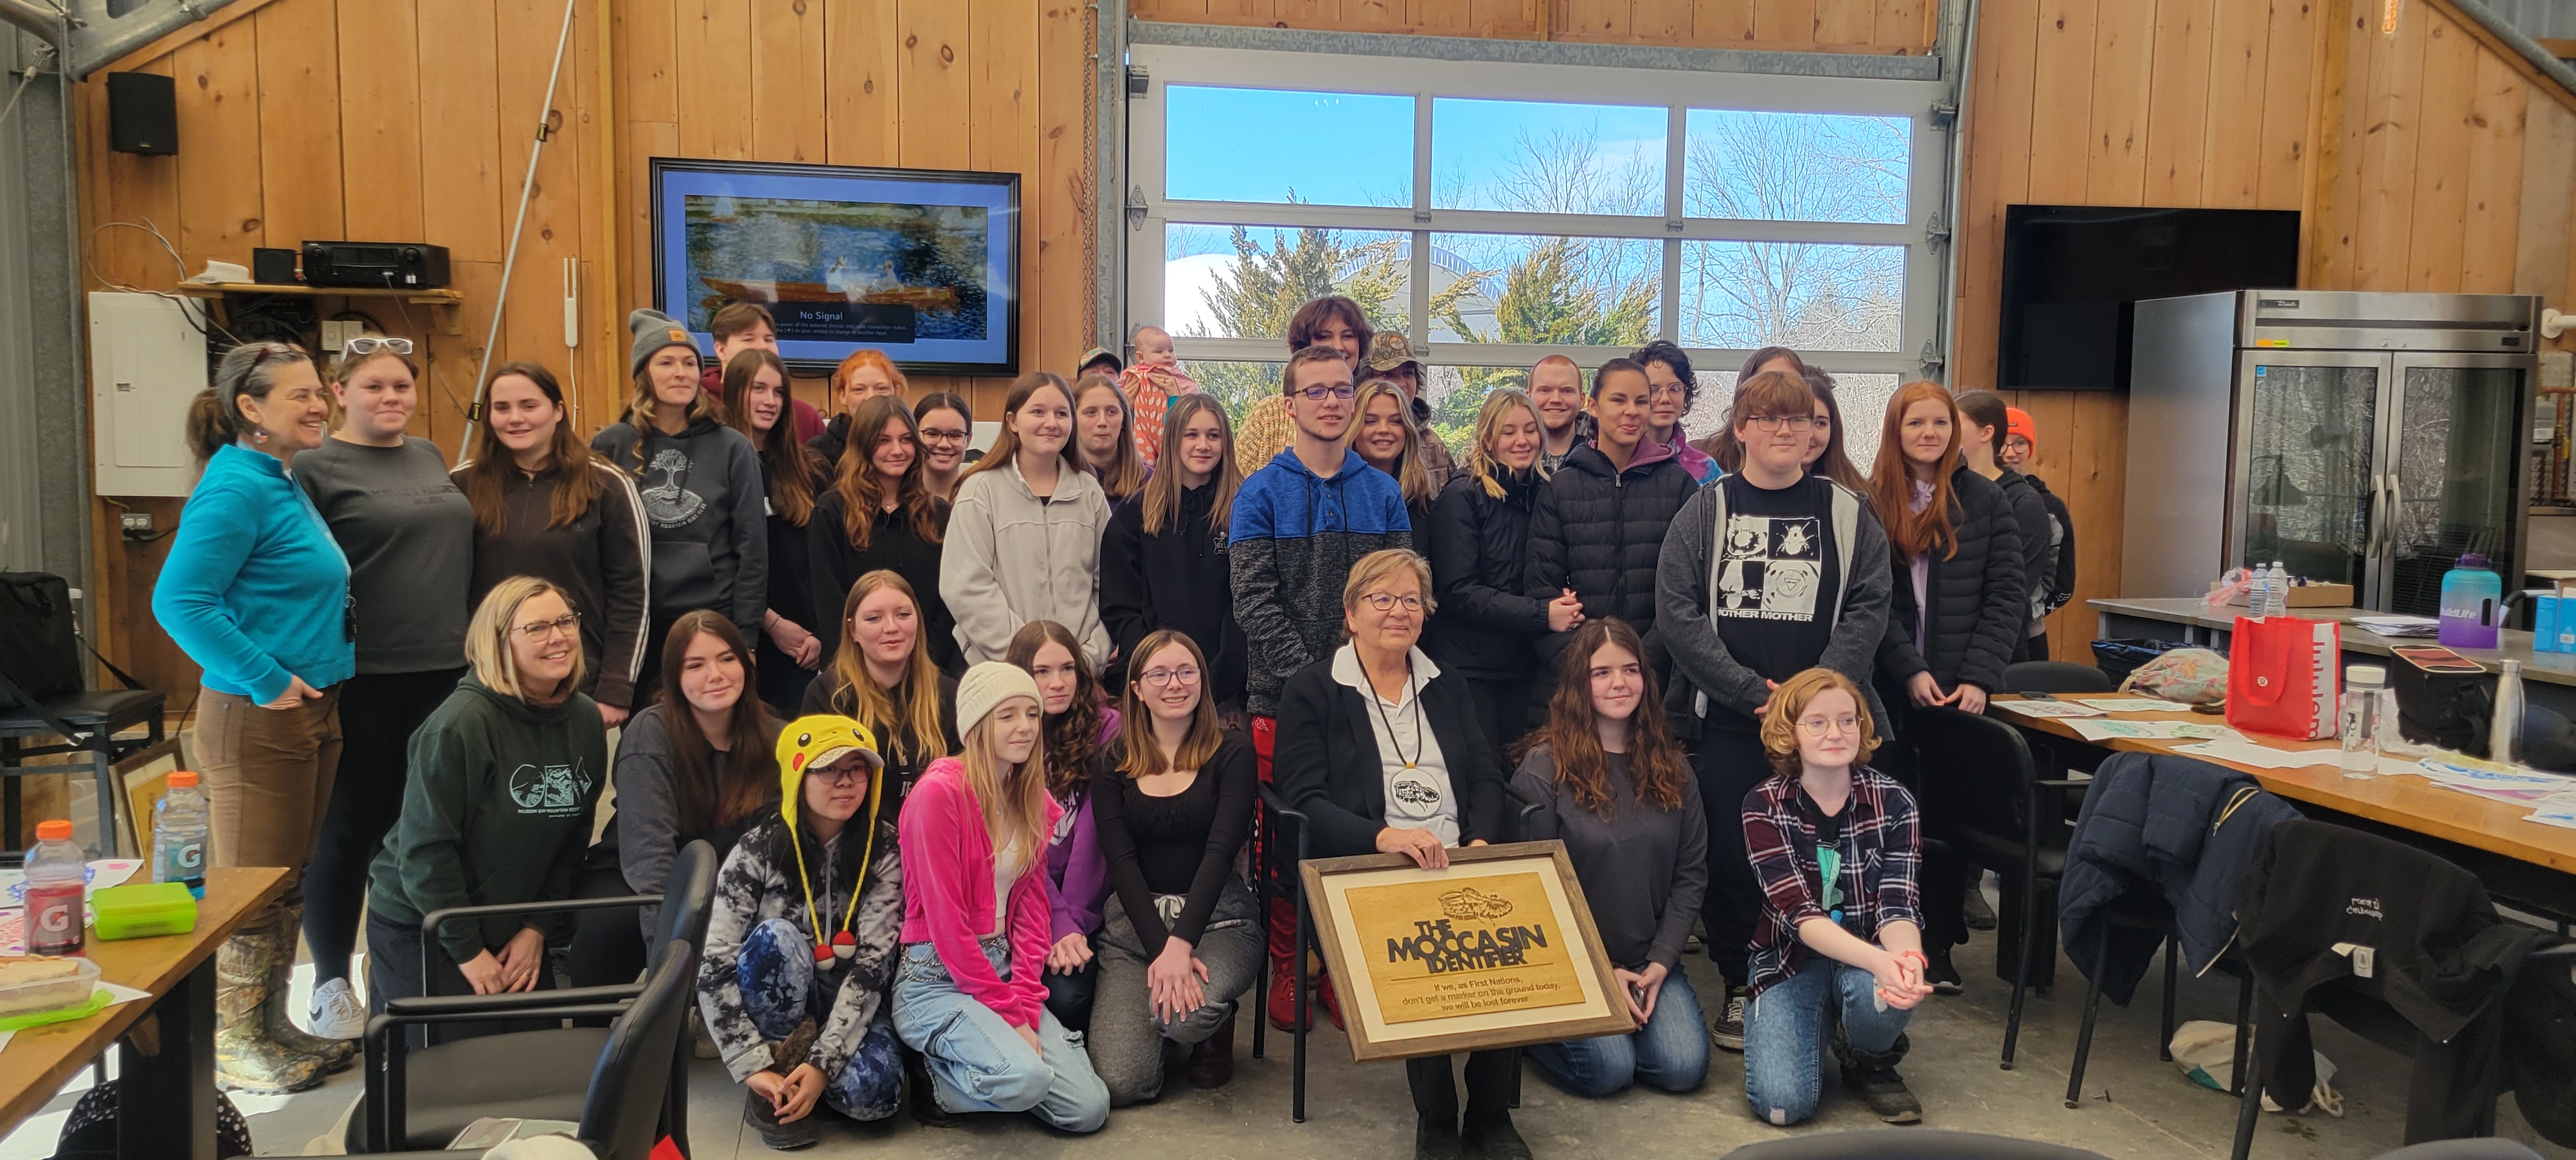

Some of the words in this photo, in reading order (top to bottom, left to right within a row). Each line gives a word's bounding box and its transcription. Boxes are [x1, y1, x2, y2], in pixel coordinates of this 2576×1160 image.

[800, 311, 813, 319] No
[815, 311, 843, 322] Signal
[1761, 611, 1813, 622] MOTHER
[178, 843, 201, 869] G
[40, 904, 69, 933] G
[1414, 919, 1452, 937] THE
[1387, 924, 1548, 963] MOCCASIN
[1425, 947, 1528, 974] IDENTIFIER
[1469, 978, 1489, 988] First
[1489, 977, 1523, 986] Nations,
[1402, 996, 1424, 1005] don't
[1425, 994, 1439, 1004] get
[1448, 991, 1476, 1000] marker
[1505, 984, 1535, 995] ground
[1535, 982, 1560, 991] today,
[1455, 1001, 1469, 1009] will
[1483, 998, 1499, 1007] lost
[1499, 996, 1529, 1005] forever
